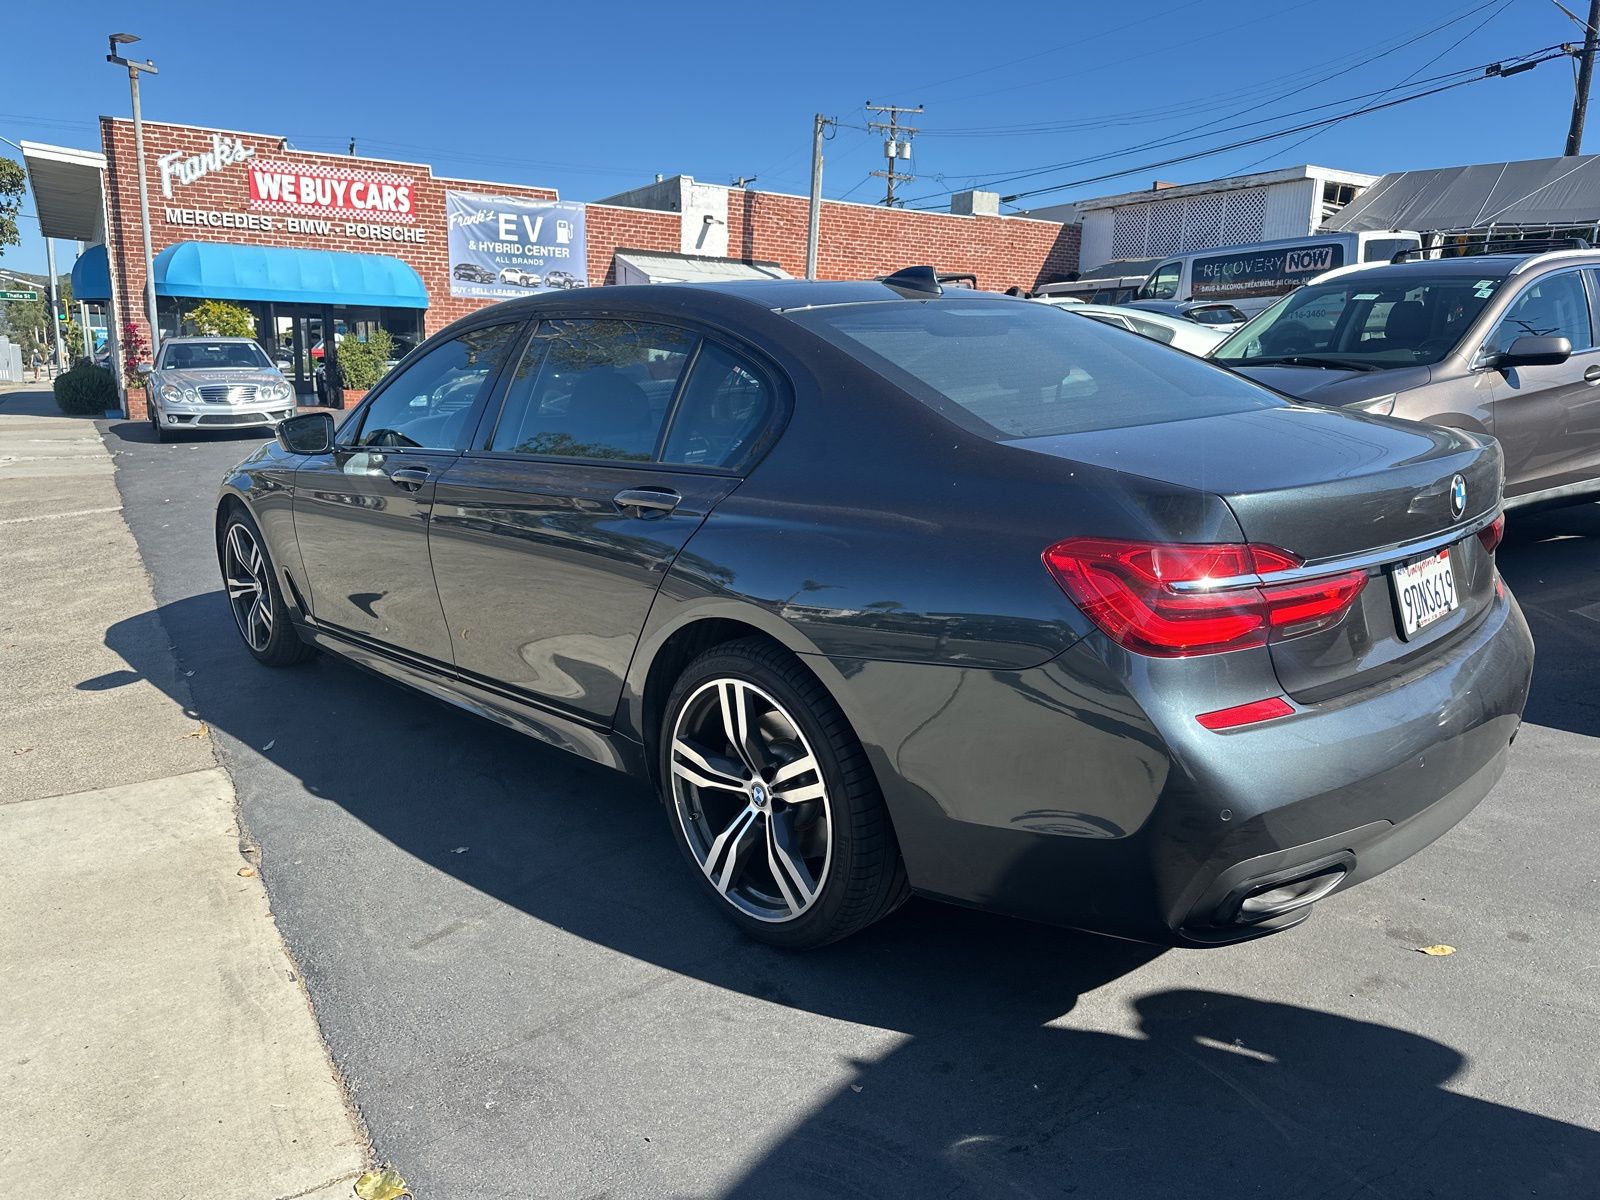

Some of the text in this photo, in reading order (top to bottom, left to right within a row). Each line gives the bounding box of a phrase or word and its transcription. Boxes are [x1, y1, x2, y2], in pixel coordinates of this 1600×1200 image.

[157, 133, 255, 199] Frank's
[253, 171, 411, 213] WE BUY CARS
[165, 207, 426, 243] MERCEDES BMW PORSCHE
[449, 209, 496, 231] Frank's
[498, 212, 544, 243] EV
[468, 240, 570, 258] & HYBRID CENTER
[495, 256, 545, 266] ALL BRANDS
[1203, 248, 1332, 277] RECOVERY NOW
[451, 286, 466, 294] BUY
[471, 287, 489, 295] SELL
[1221, 283, 1244, 291] ALCOHOL
[1403, 569, 1453, 625] 9DNS619
